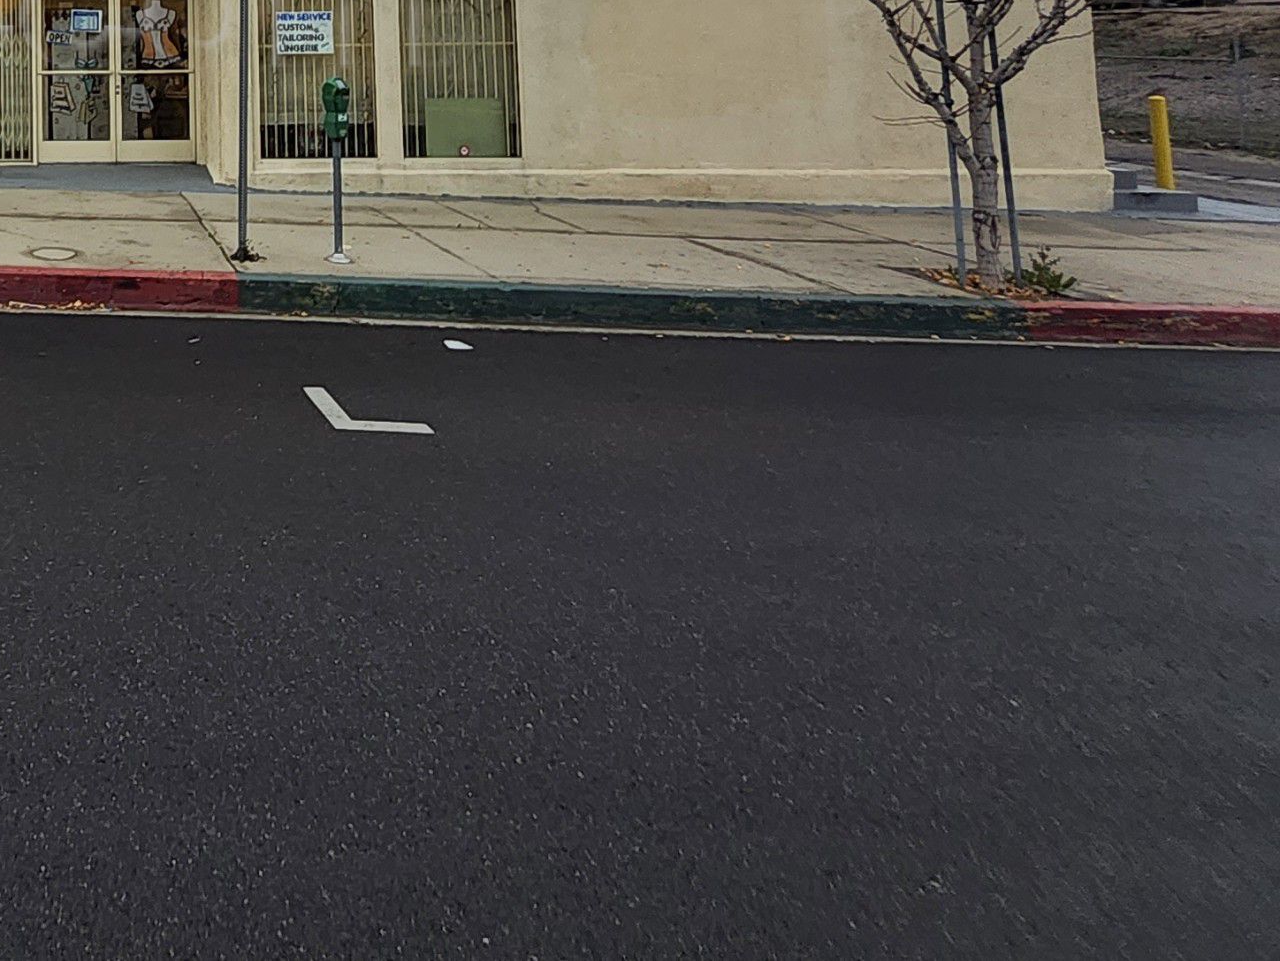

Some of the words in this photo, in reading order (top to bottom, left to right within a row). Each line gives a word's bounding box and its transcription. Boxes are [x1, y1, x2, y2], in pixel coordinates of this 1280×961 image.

[276, 13, 295, 21] NEW
[297, 12, 332, 21] SERVICE
[277, 23, 314, 32] CUSTOM
[48, 32, 70, 44] OPEN
[277, 33, 325, 42] TAILORING
[279, 44, 319, 53] LINGERIE
